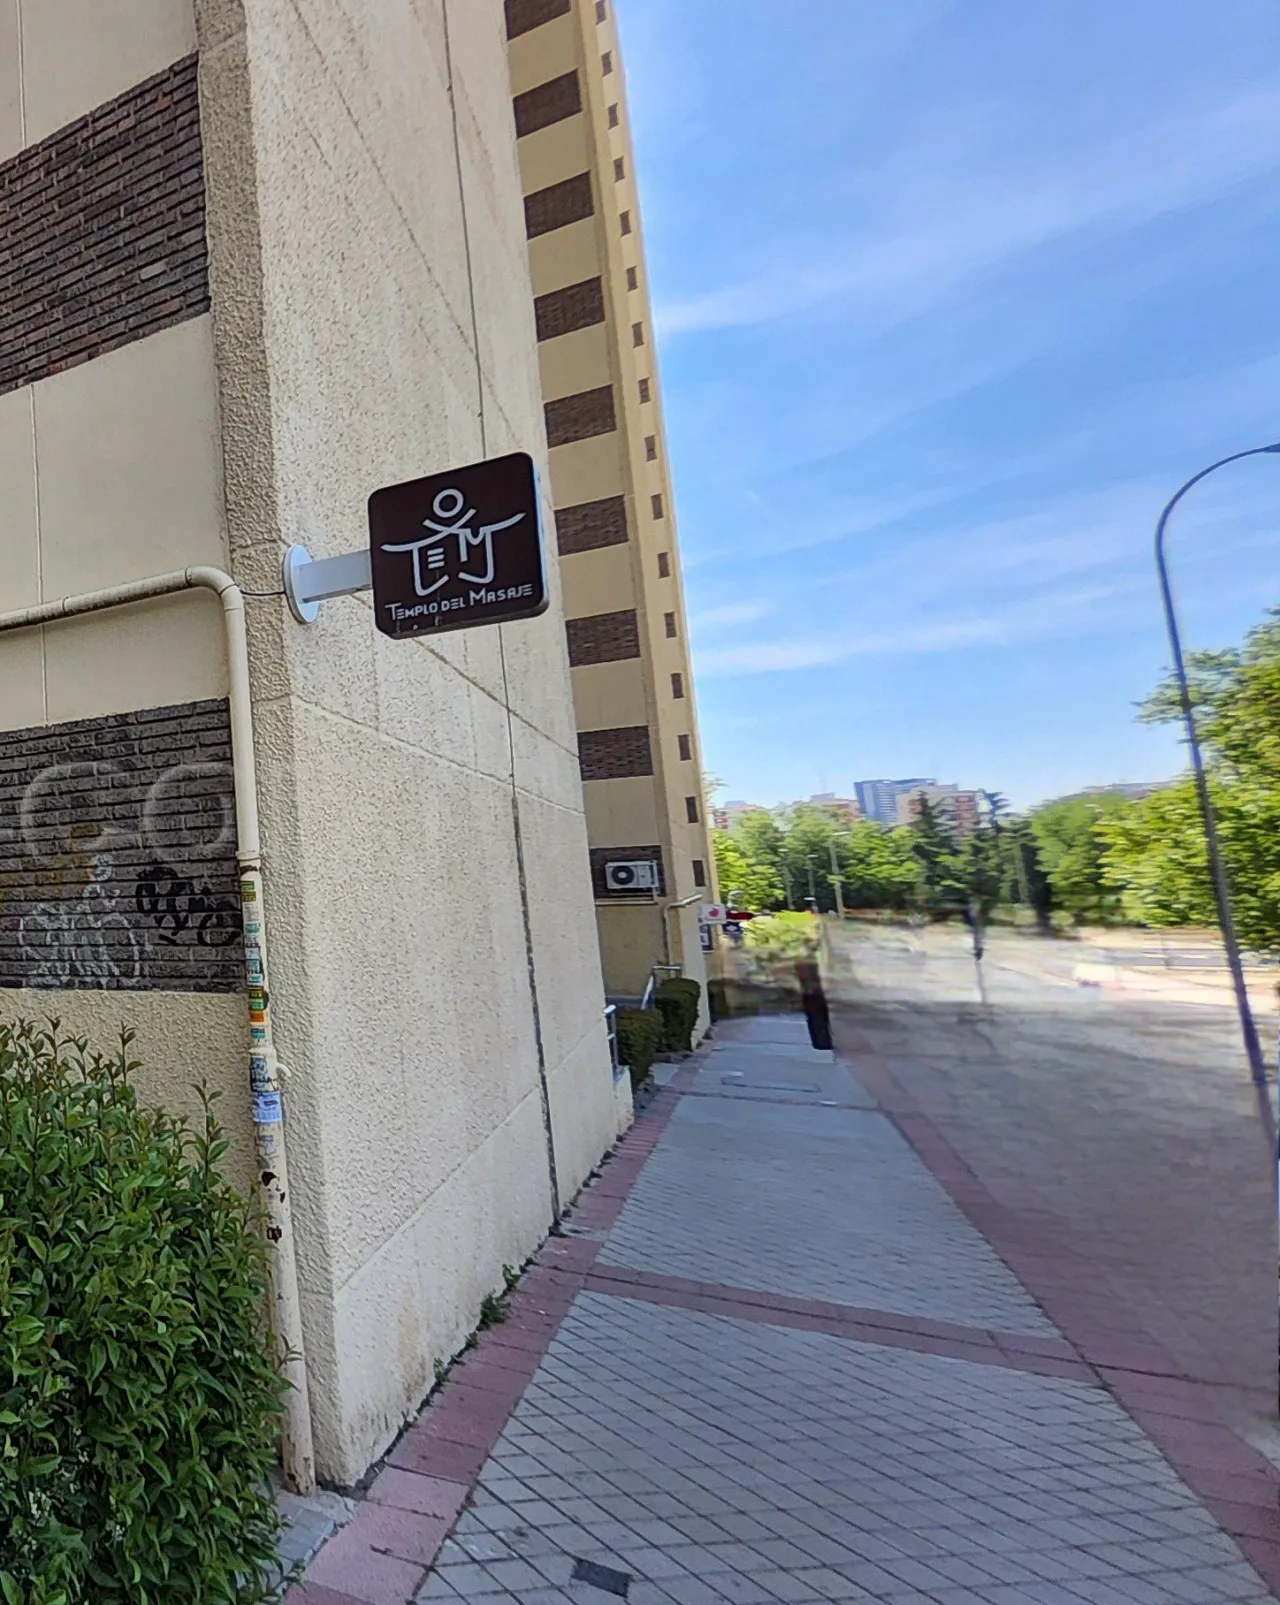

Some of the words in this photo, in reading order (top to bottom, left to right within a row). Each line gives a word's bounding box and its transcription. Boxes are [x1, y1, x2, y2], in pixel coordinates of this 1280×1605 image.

[385, 602, 438, 621] TEMPLO
[441, 597, 466, 612] DEL
[470, 584, 533, 606] MASAJE
